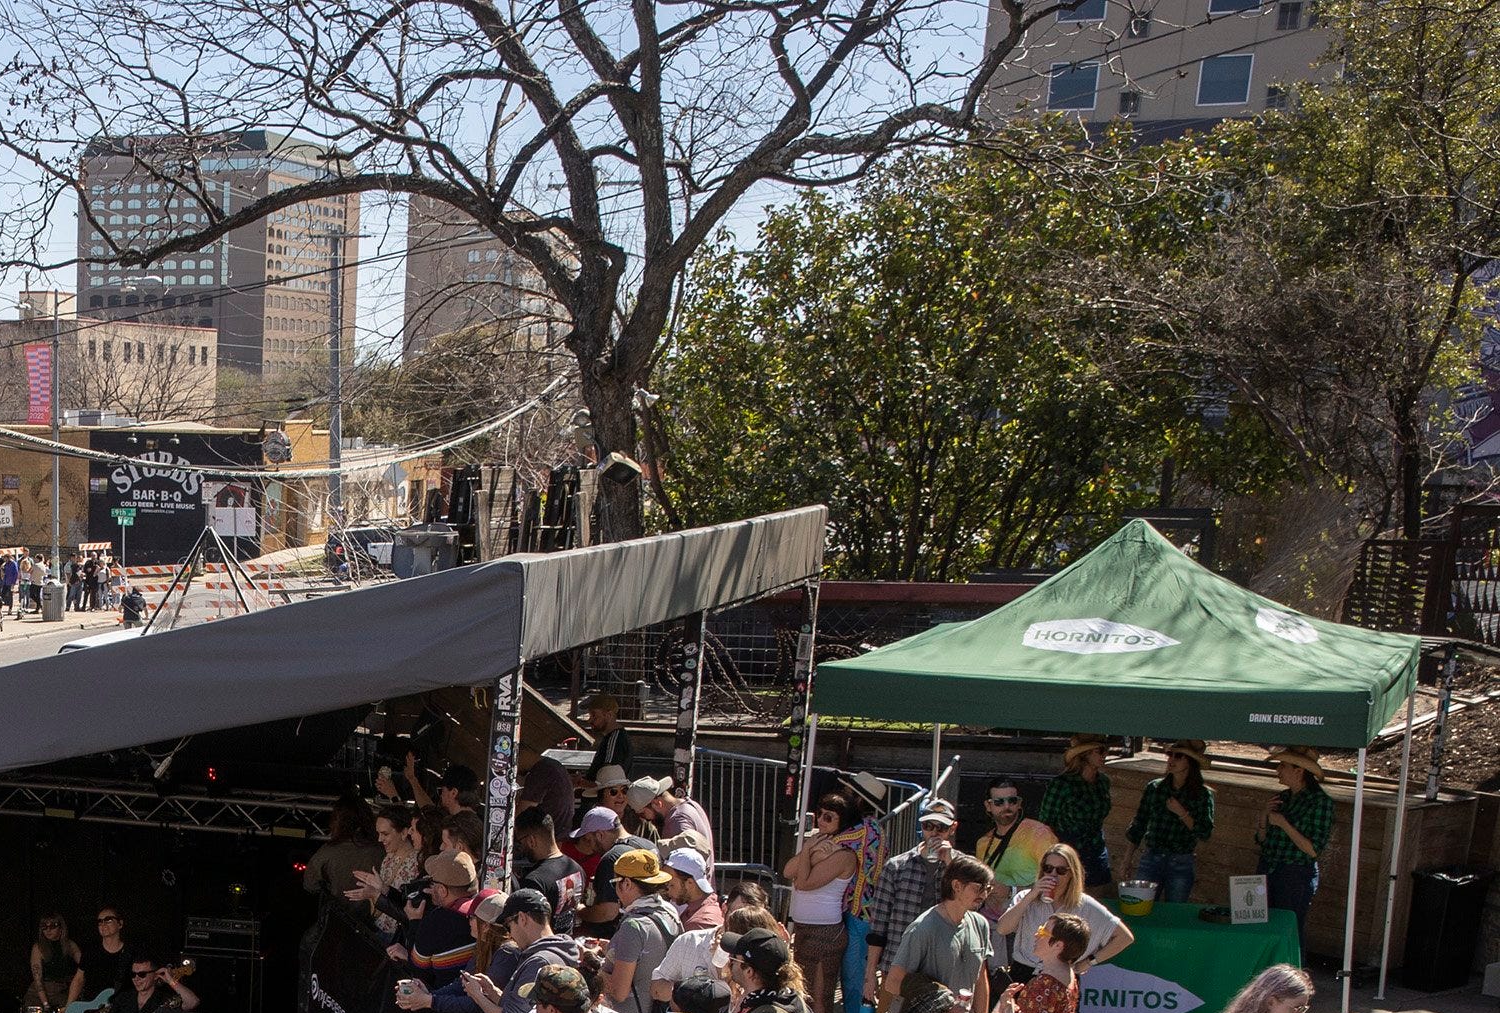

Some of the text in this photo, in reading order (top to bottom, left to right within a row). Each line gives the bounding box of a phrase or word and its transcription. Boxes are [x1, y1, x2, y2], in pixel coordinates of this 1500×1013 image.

[1034, 630, 1156, 646] HORNITOS
[498, 673, 513, 711] RVA
[1249, 713, 1325, 726] DRINK RESPONSIBLY.
[1080, 988, 1178, 1010] RNITOS
